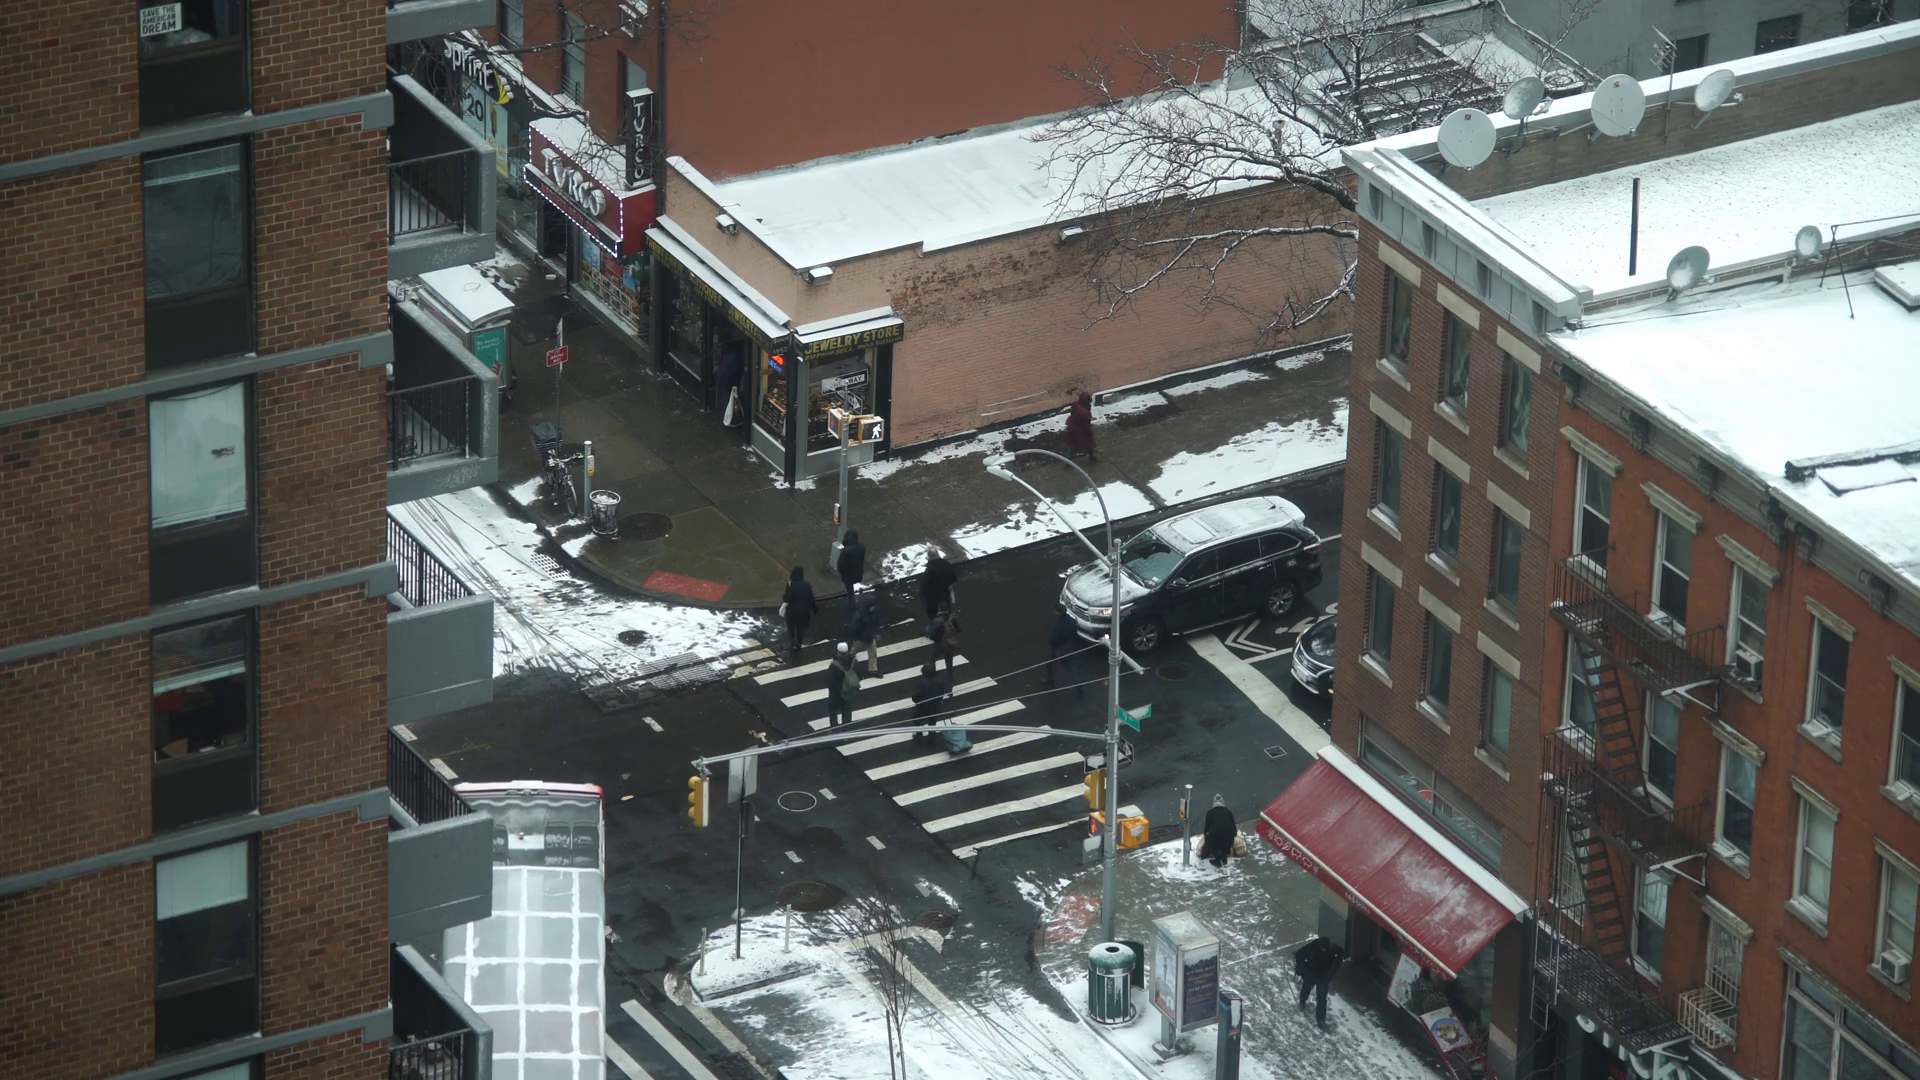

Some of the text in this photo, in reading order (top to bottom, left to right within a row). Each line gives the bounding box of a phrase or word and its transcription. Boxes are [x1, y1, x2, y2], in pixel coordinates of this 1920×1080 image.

[142, 4, 176, 18] SAVE THE
[142, 13, 176, 25] AMERICAN
[142, 20, 176, 35] DREAM
[804, 324, 900, 355] JEWELRY STORE
[848, 375, 862, 384] WAY
